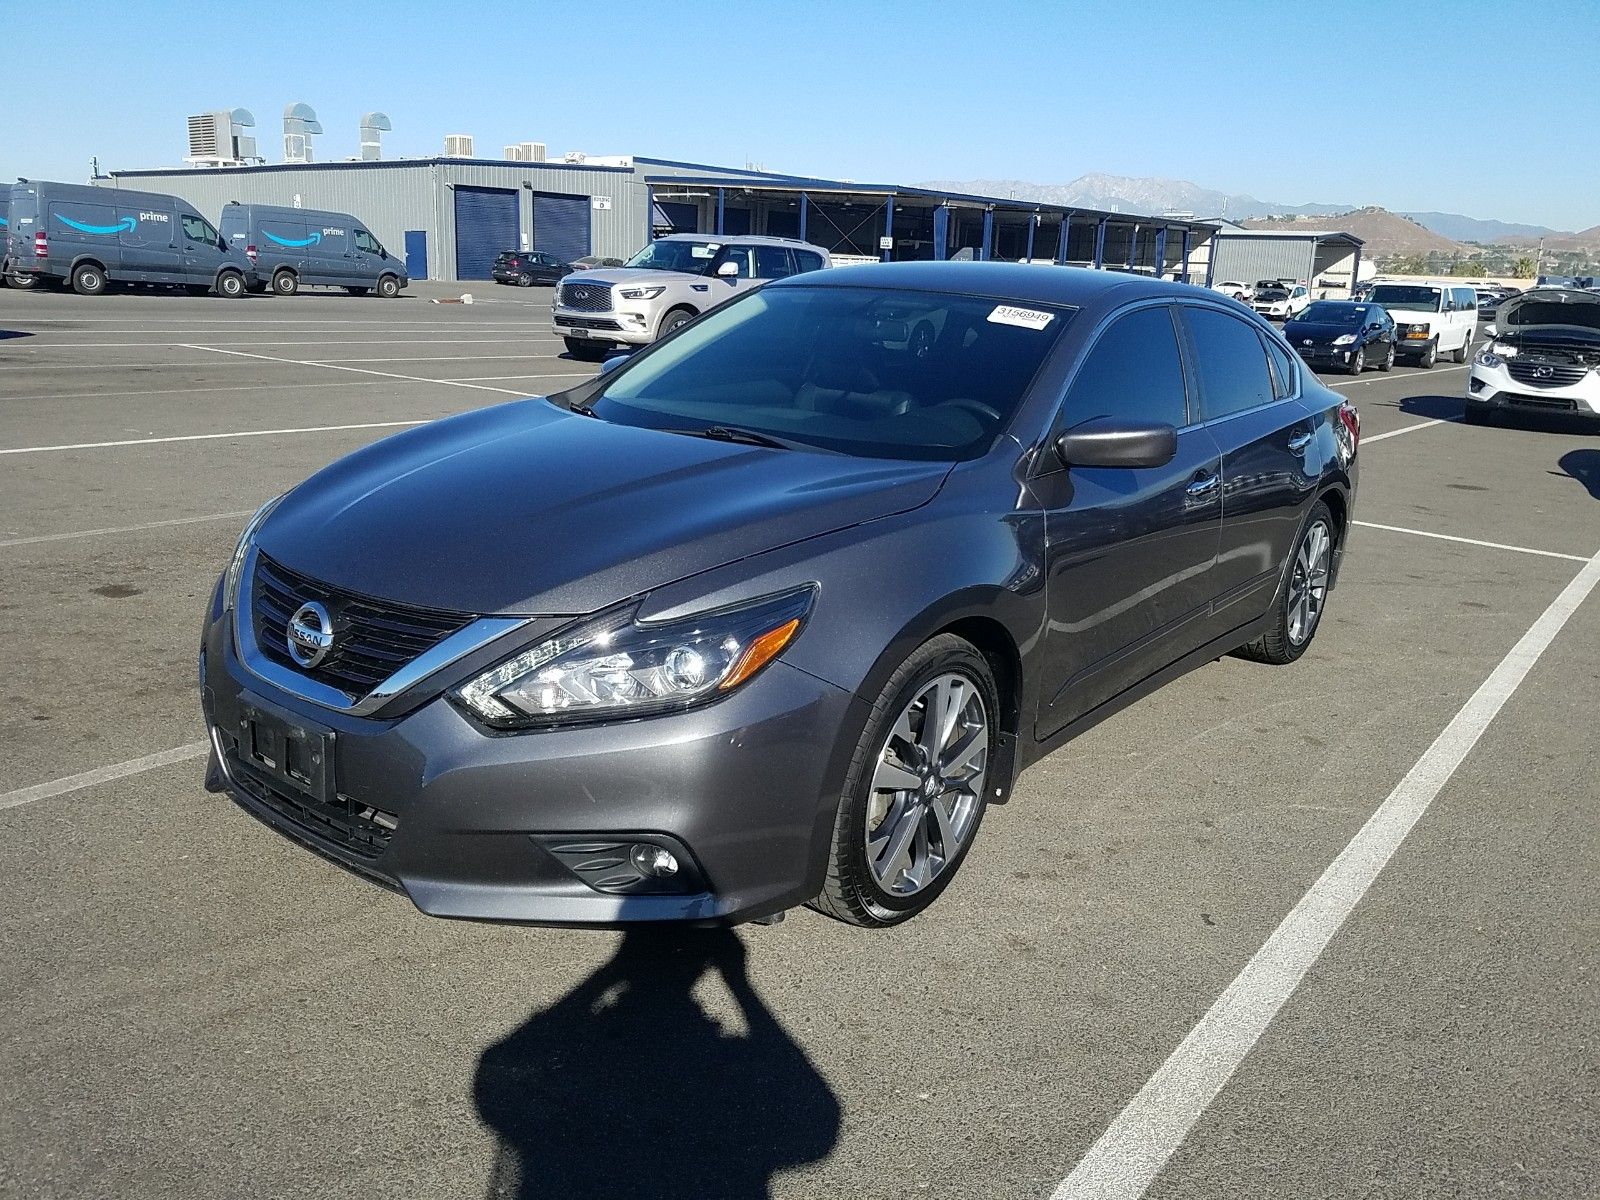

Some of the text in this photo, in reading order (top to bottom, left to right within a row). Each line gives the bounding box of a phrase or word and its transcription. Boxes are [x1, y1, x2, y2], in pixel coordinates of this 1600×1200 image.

[140, 211, 168, 222] prime
[323, 227, 344, 236] prime
[998, 308, 1049, 321] 3156949
